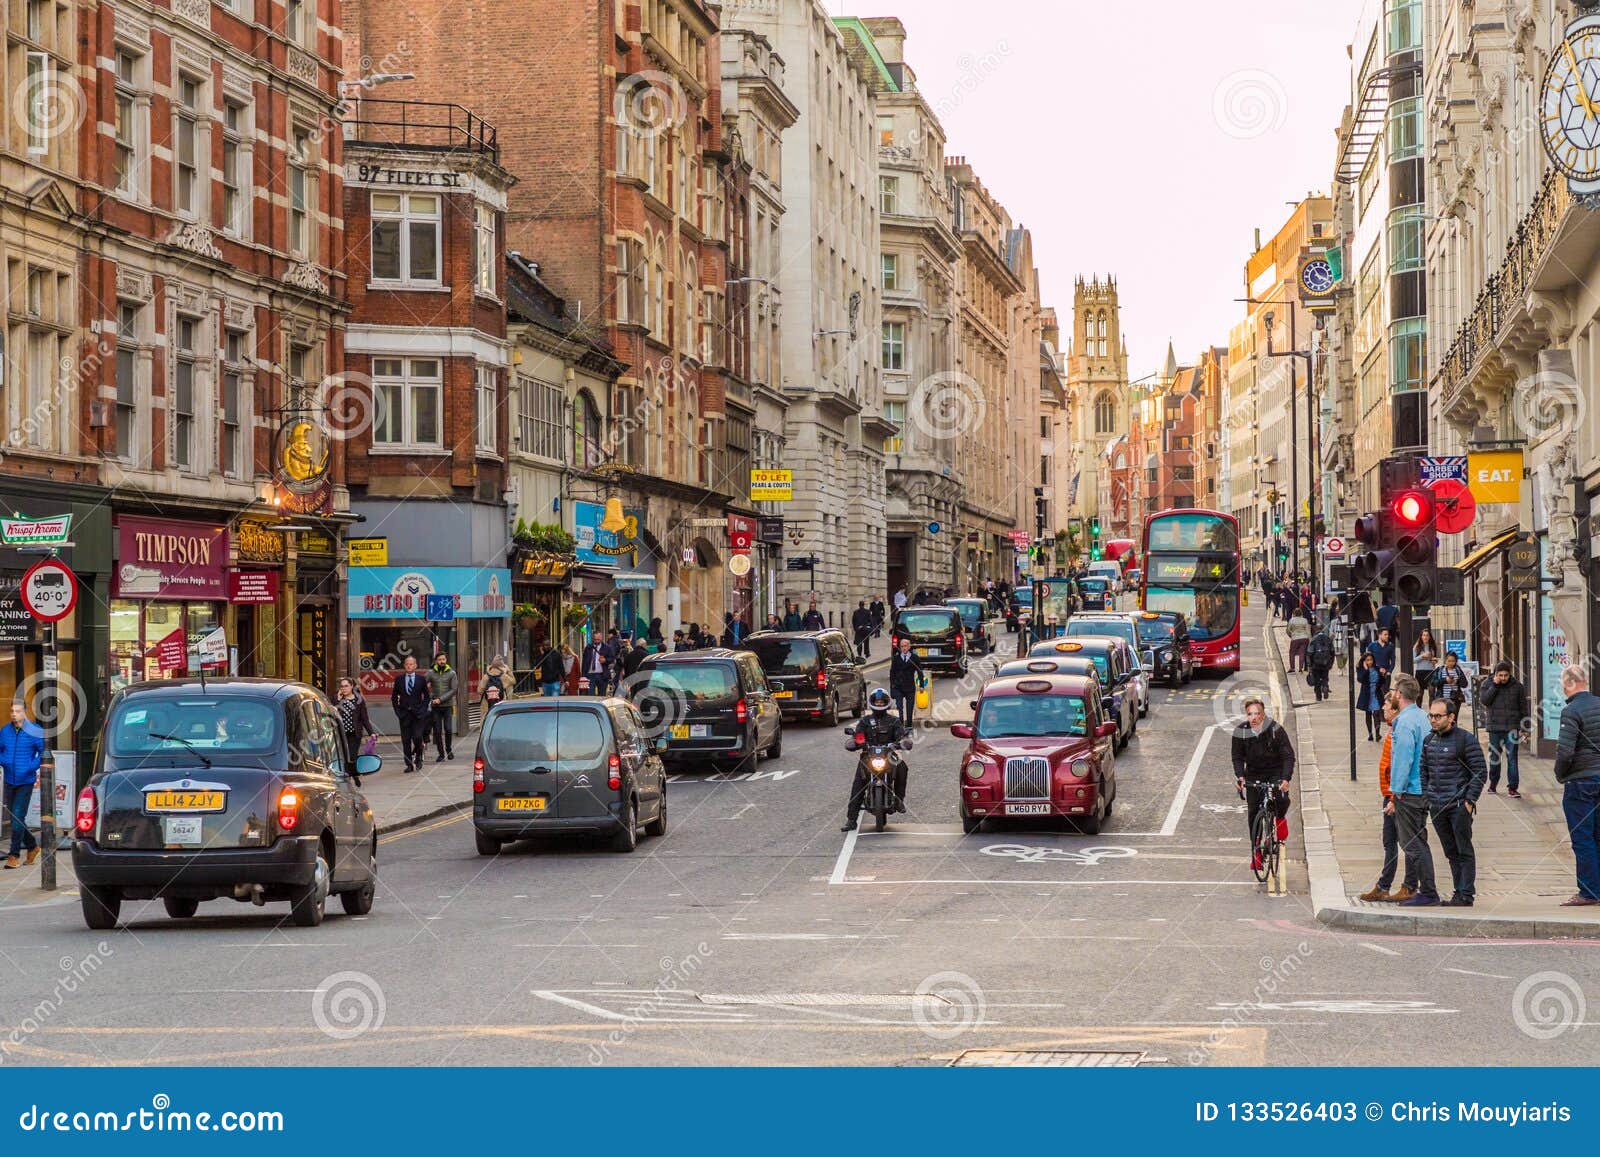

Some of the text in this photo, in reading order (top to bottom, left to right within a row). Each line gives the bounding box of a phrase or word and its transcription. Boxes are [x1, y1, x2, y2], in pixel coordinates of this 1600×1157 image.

[358, 164, 381, 183] 97
[387, 168, 433, 186] FLEET
[1478, 469, 1514, 482] EAT.
[136, 532, 210, 566] TIMPSON
[1211, 565, 1220, 576] 4
[364, 594, 412, 611] RETRO
[155, 794, 215, 807] LL14 ZJY
[523, 799, 541, 809] ZKG
[1008, 805, 1047, 814] LM60 RYA
